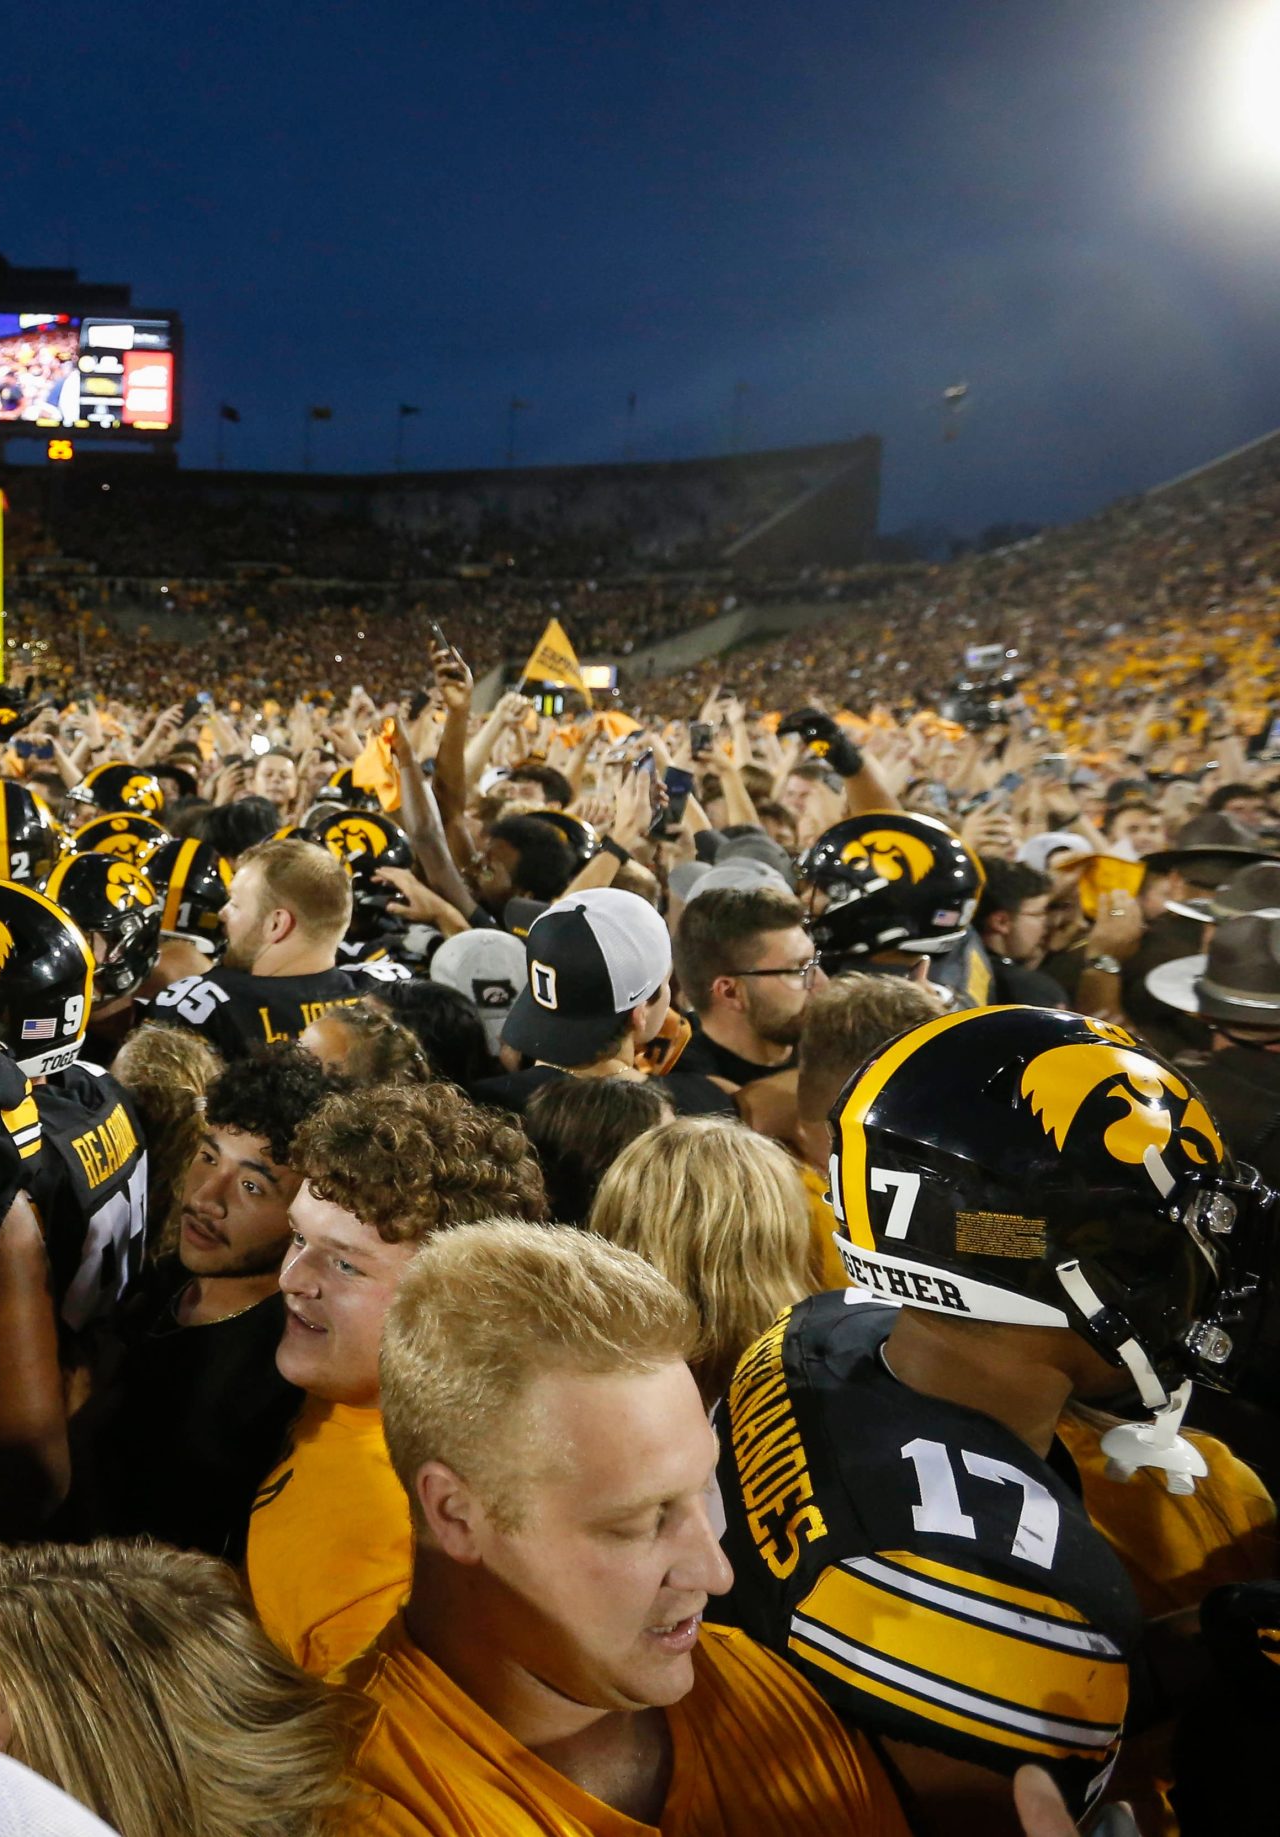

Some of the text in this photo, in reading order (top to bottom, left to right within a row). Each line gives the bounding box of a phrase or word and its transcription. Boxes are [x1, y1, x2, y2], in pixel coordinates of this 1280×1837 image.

[156, 975, 230, 1024] 95
[838, 1248, 972, 1313] GETHER
[900, 1437, 1060, 1570] 17
